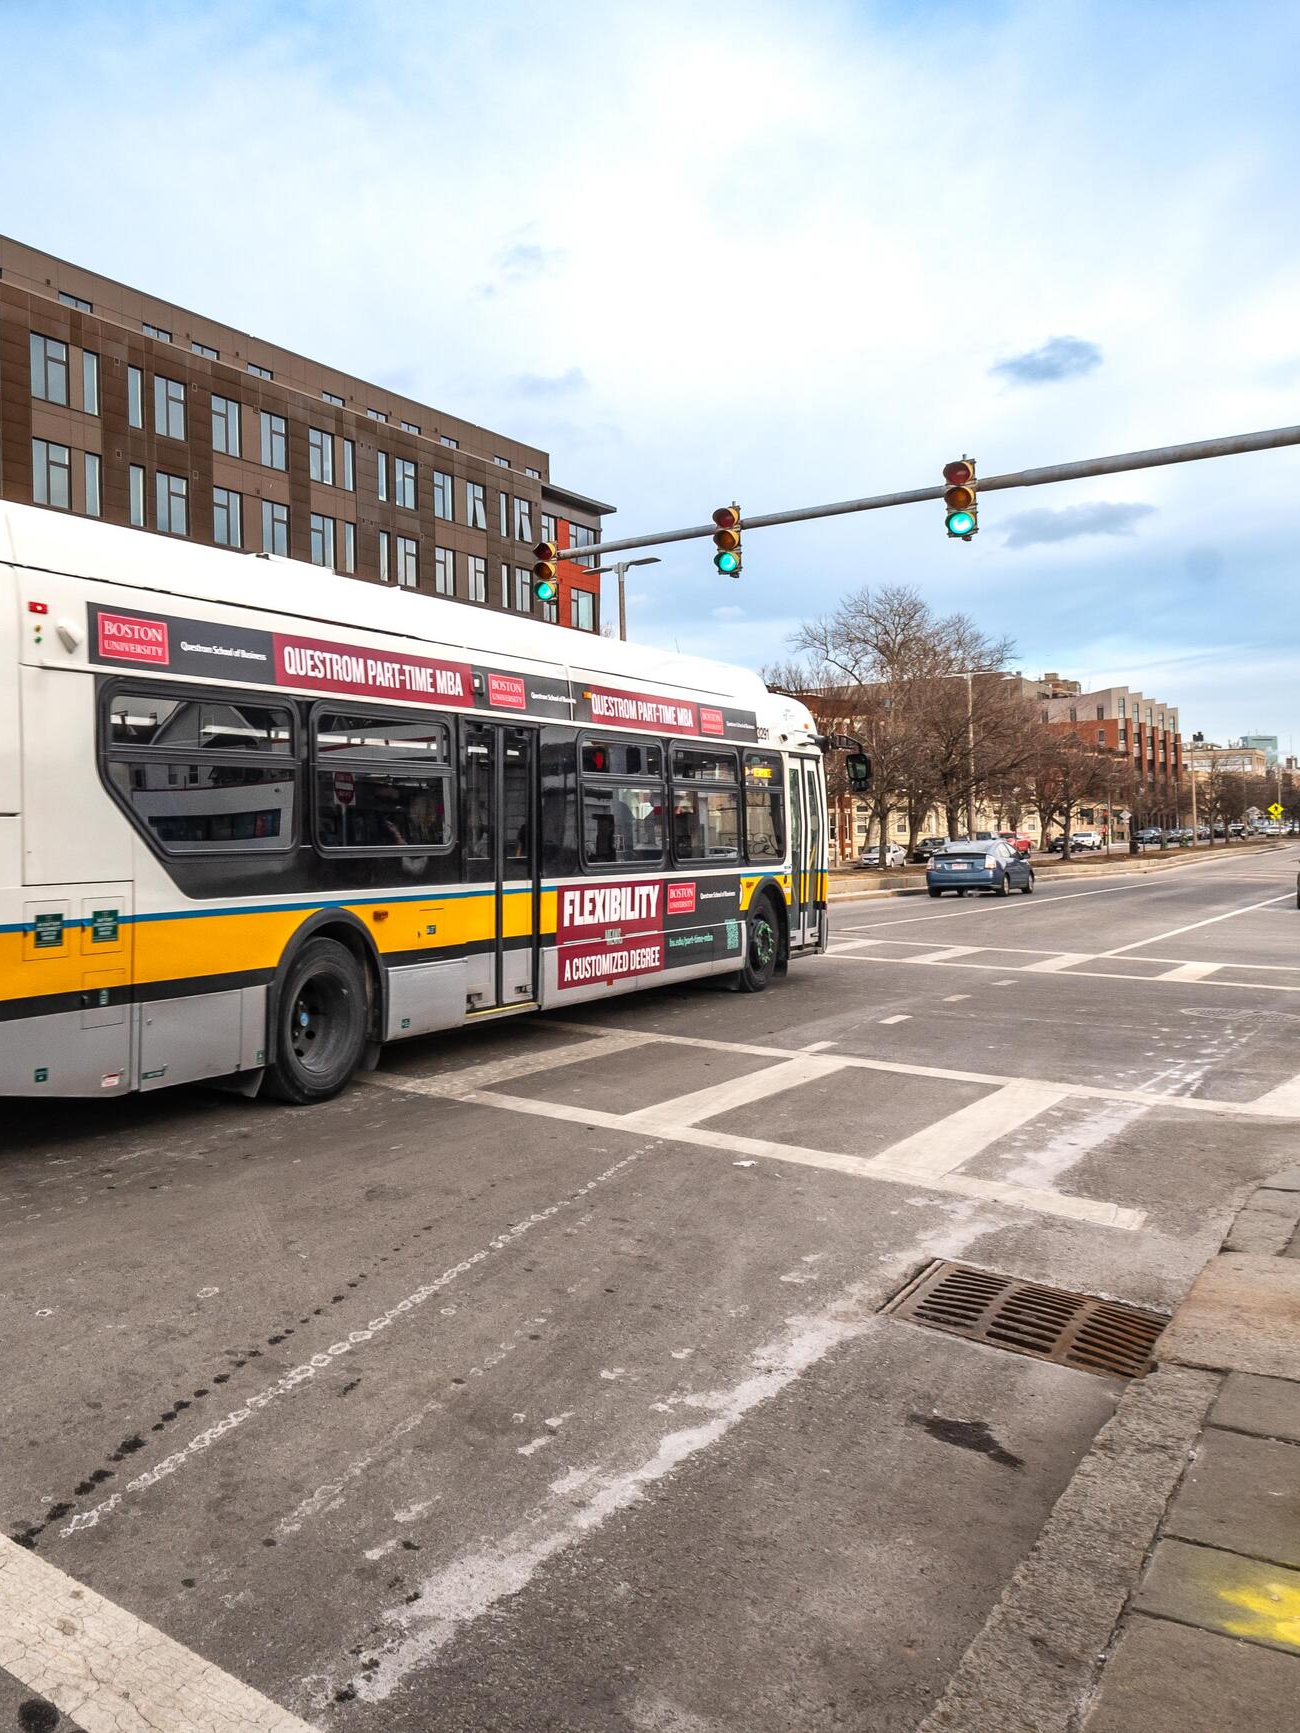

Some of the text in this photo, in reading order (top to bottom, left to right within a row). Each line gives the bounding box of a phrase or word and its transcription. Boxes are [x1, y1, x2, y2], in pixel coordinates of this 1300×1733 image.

[103, 620, 163, 642] BOSTON
[104, 639, 164, 657] UNIVERSITY
[284, 646, 464, 697] QUESTROM PART-TIME MBA
[491, 680, 522, 693] BOSTON
[492, 692, 523, 704] UNIVERSITY
[591, 693, 693, 728] QUESTROM PART-TIME MBA
[669, 887, 693, 900] BOSTON
[563, 884, 660, 927] FLEXIBILITY
[669, 900, 693, 909] UNIVERSITY
[604, 928, 623, 946] MEANS
[563, 946, 660, 982] A CUSTOMIZED DEGREE
